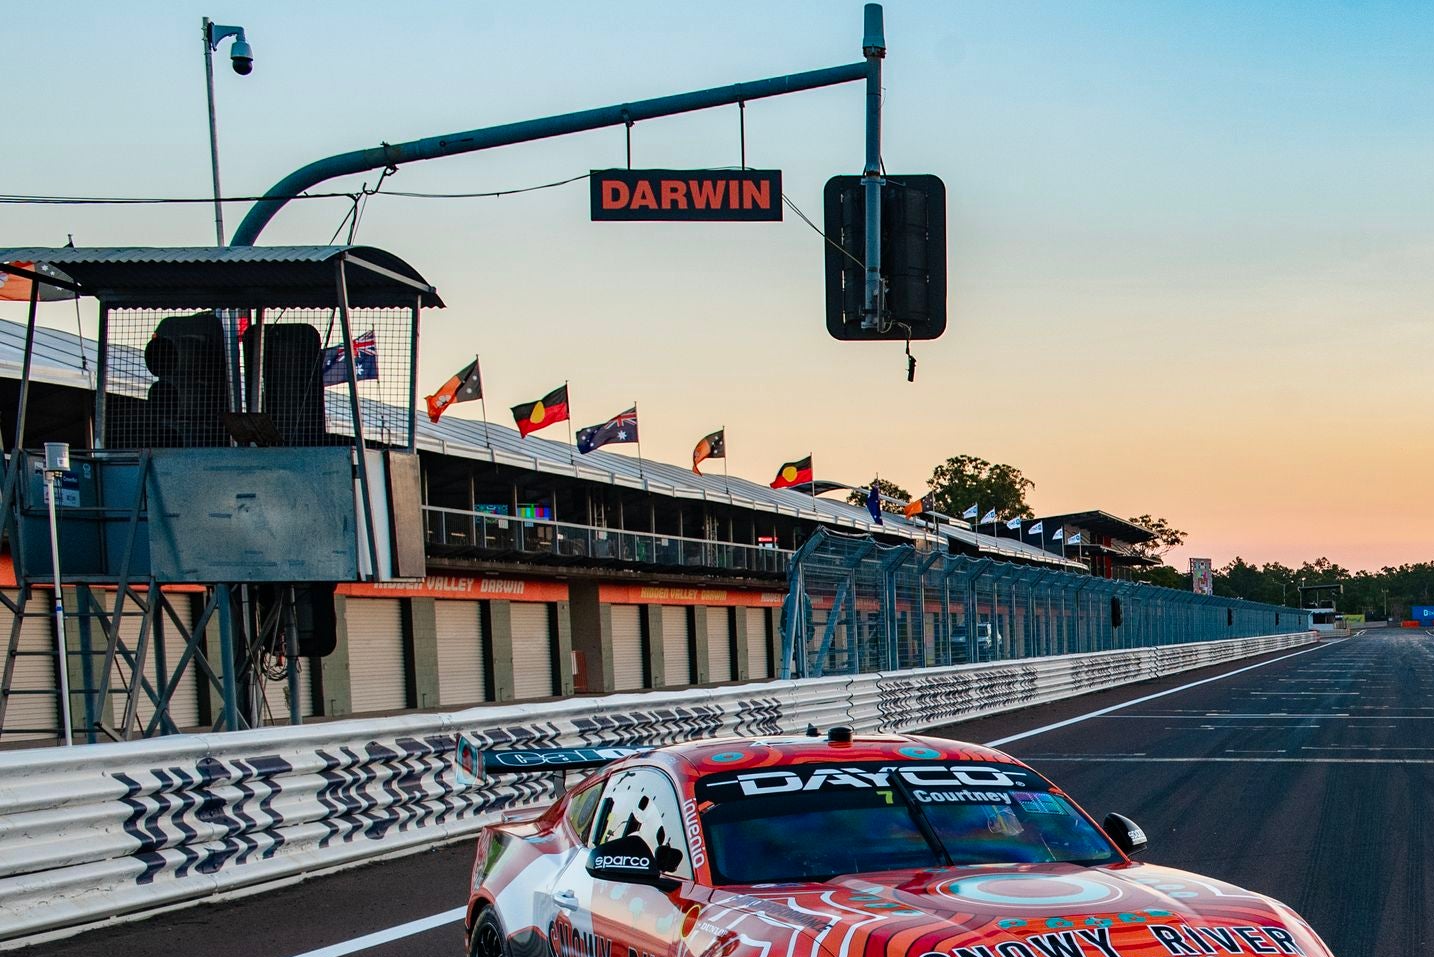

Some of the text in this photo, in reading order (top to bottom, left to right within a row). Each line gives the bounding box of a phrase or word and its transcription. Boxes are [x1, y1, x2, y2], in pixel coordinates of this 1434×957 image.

[602, 180, 770, 210] DARWIN
[426, 576, 474, 592] VALLEY
[480, 579, 525, 594] DARWIN
[670, 588, 698, 600] VALLEY
[737, 765, 1014, 796] DAYCO
[876, 791, 894, 805] 7
[913, 789, 1011, 805] Courtney
[683, 798, 705, 869] invenio
[595, 855, 650, 869] sparco
